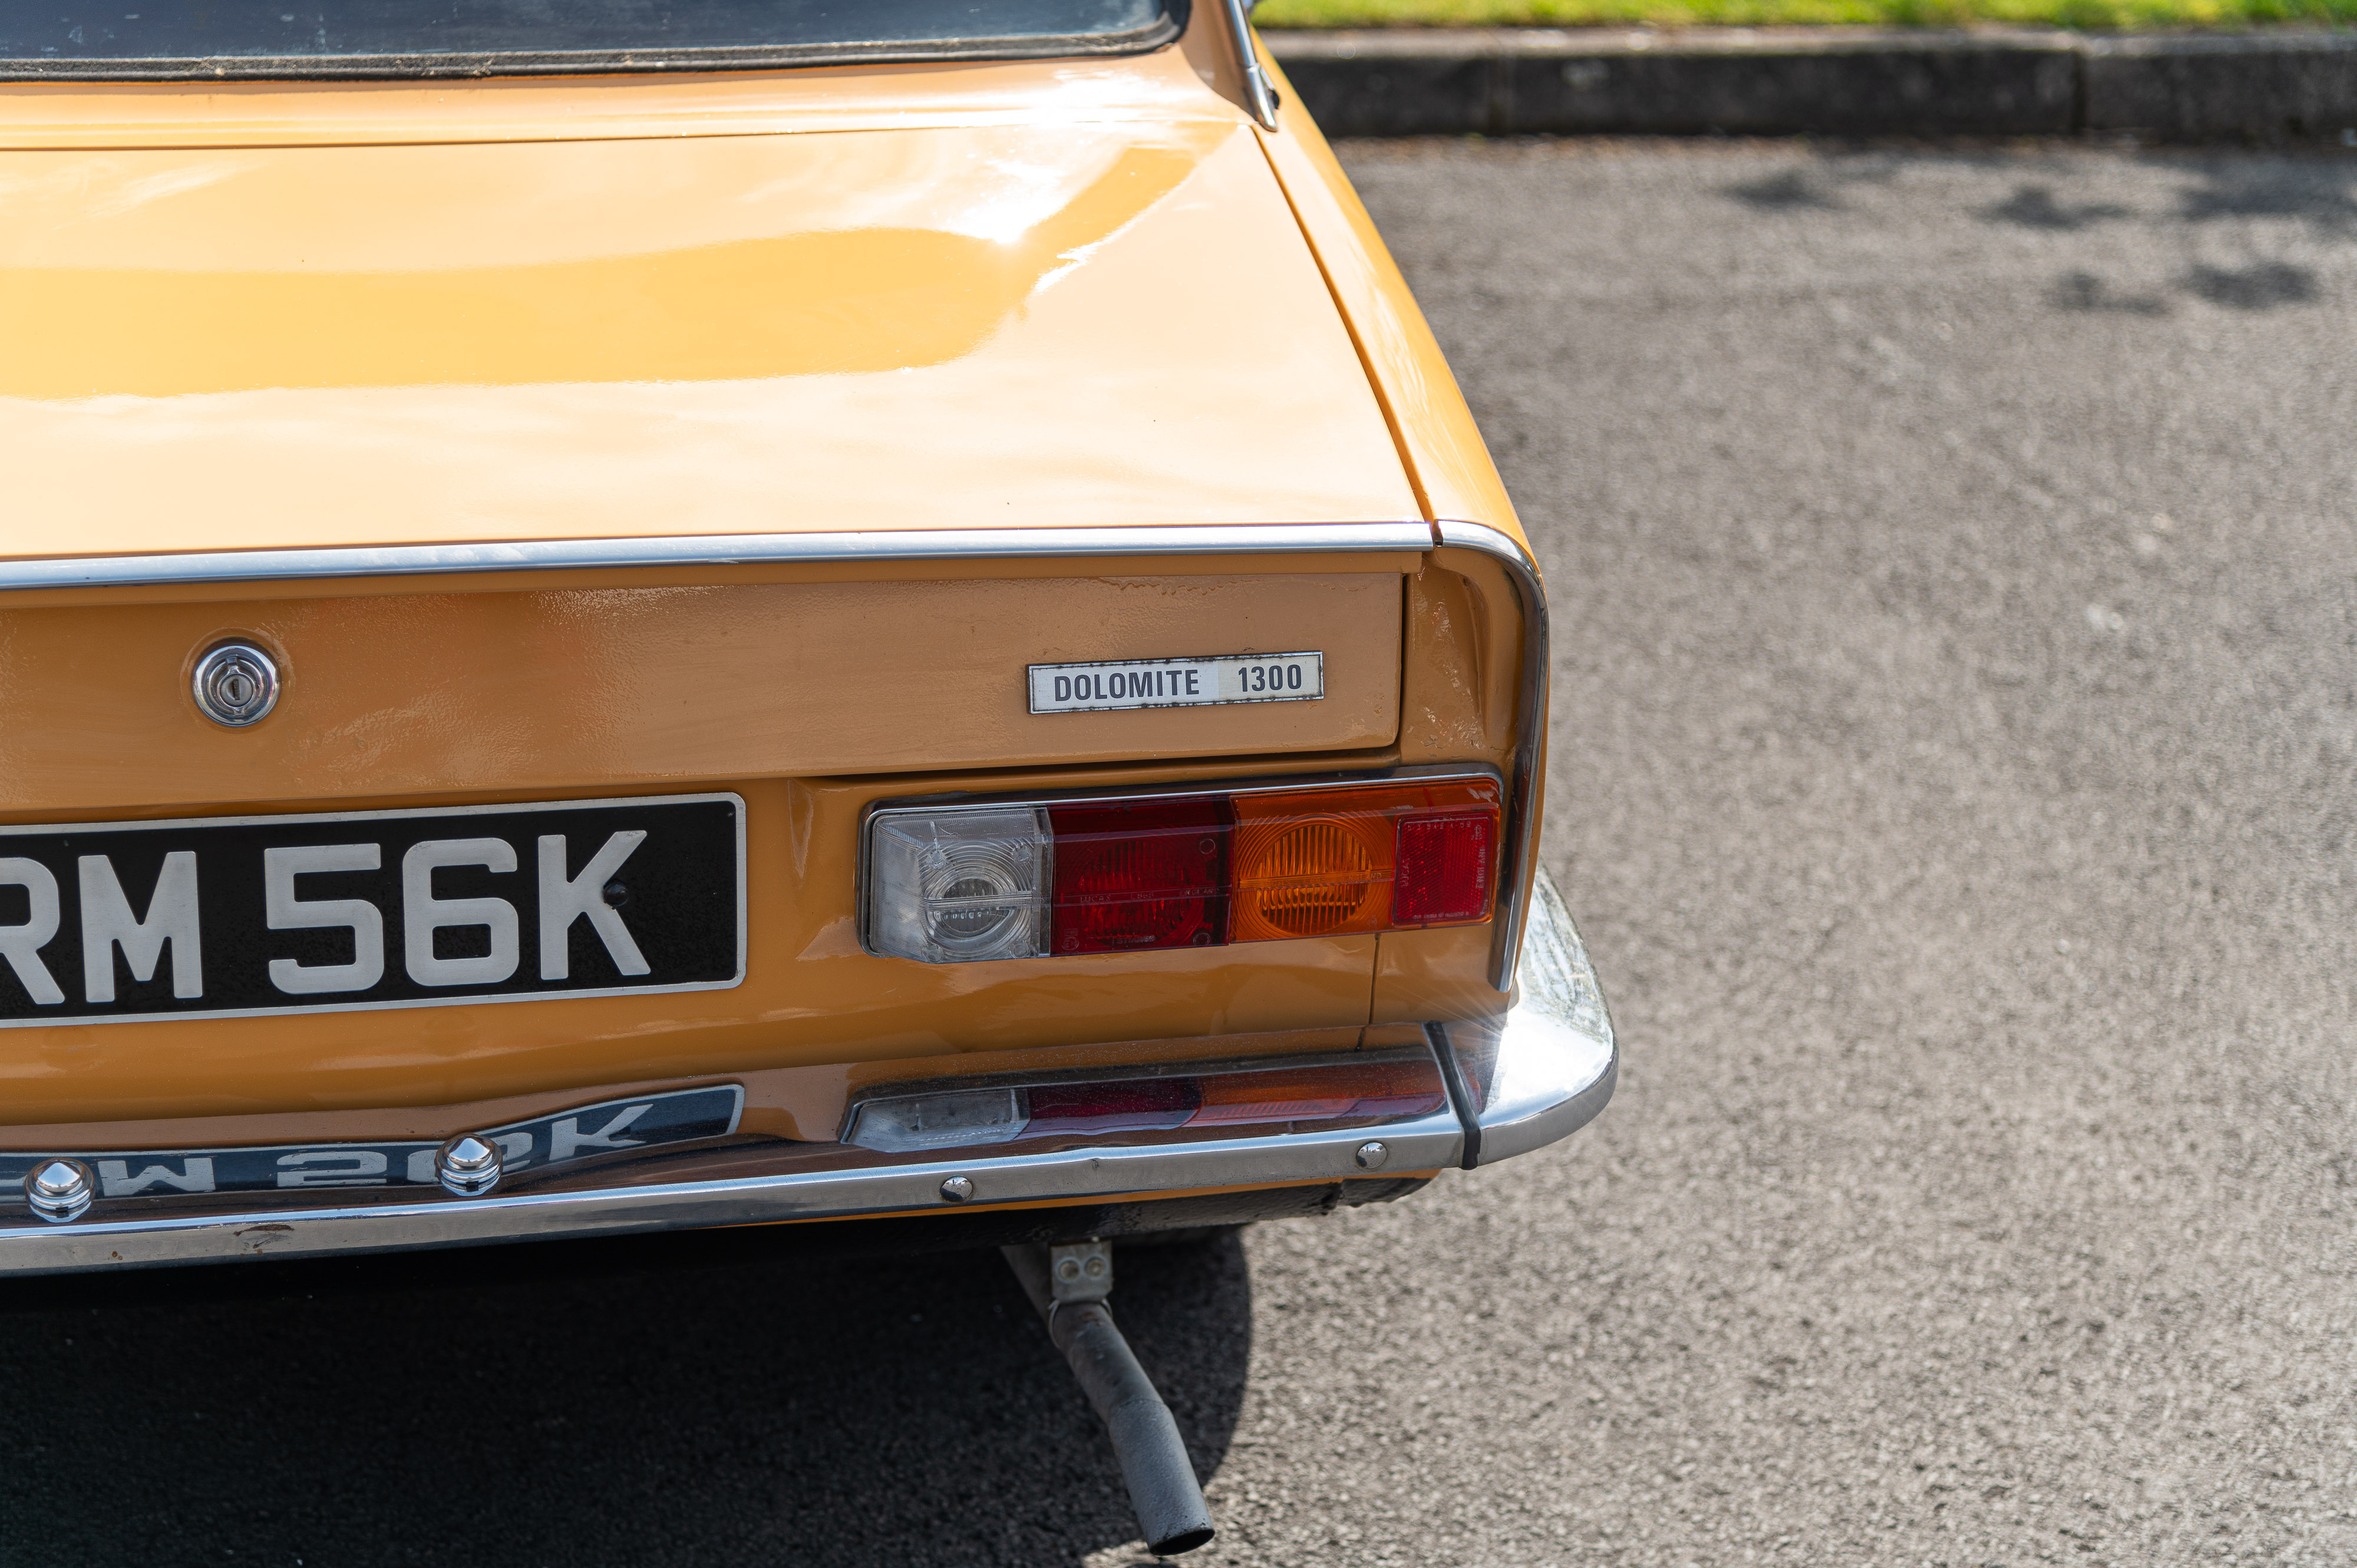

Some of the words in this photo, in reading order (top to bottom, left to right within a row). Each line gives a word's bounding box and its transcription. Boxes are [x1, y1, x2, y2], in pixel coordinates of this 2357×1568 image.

[1054, 669, 1200, 702] DOLOMITE
[1238, 664, 1302, 693] 1300
[0, 850, 203, 1005] RM
[264, 830, 652, 995] 56K
